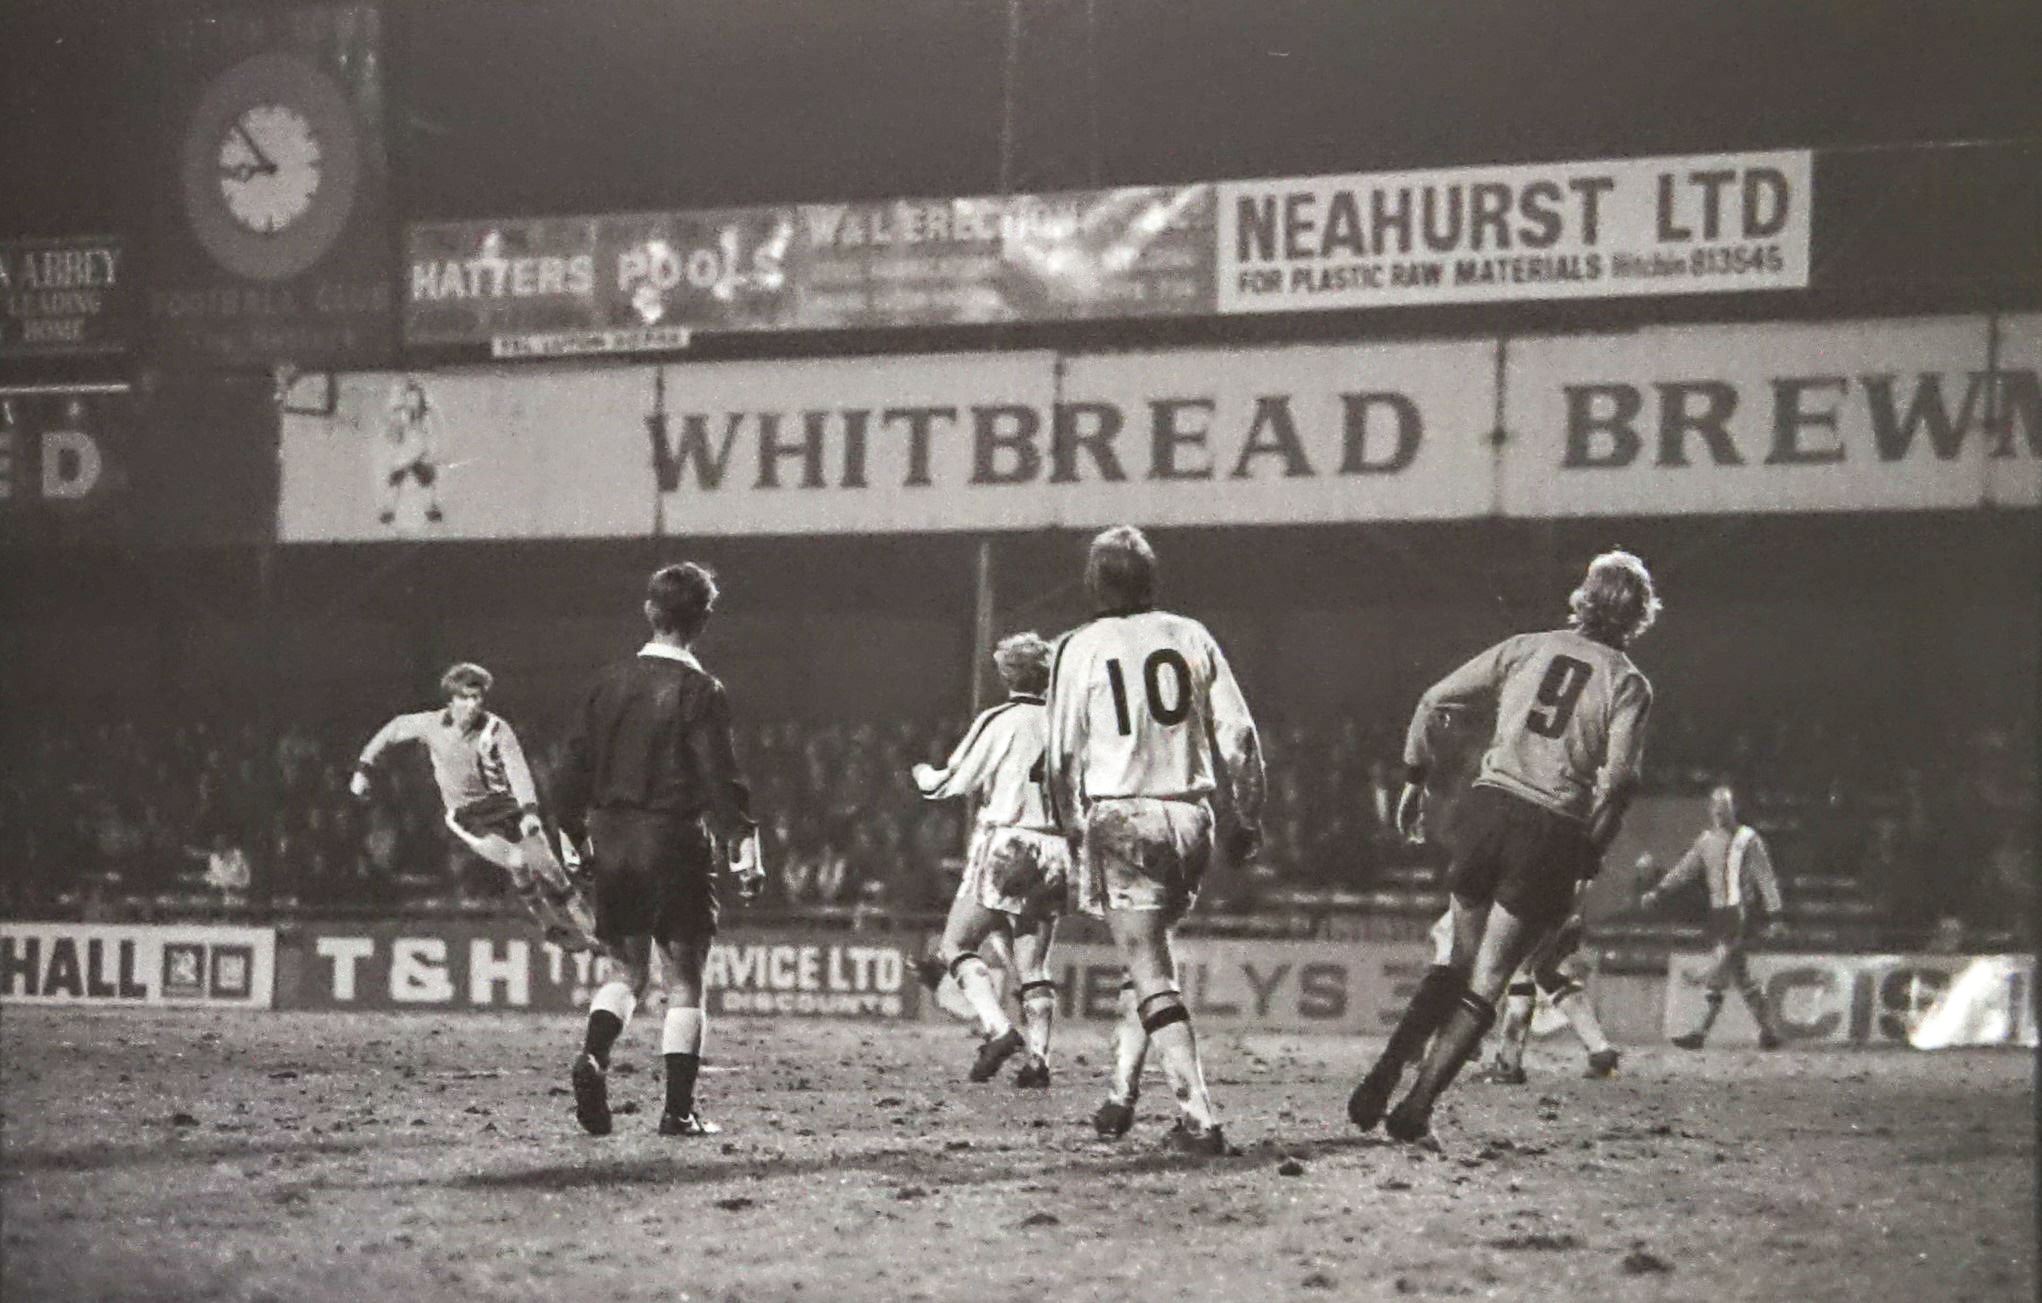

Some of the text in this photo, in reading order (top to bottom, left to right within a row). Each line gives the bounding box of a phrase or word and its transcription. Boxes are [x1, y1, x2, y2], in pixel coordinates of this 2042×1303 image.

[1235, 167, 1790, 262] NEAHURST LTD
[411, 256, 594, 301] HATTERS
[1238, 268, 1283, 294] FOR
[1290, 263, 1385, 293] PLASTIC
[1391, 261, 1443, 288] RAW
[1454, 254, 1602, 287] MATERIALS
[645, 389, 1424, 493] WHITBREAD
[1106, 647, 1193, 736] 10
[1525, 654, 1594, 740] 9
[0, 936, 147, 998] HALL
[316, 937, 374, 1000] T
[390, 937, 454, 1003] &
[469, 939, 530, 1004] H
[829, 945, 900, 992] LTD
[1054, 959, 1348, 1021] HELYS
